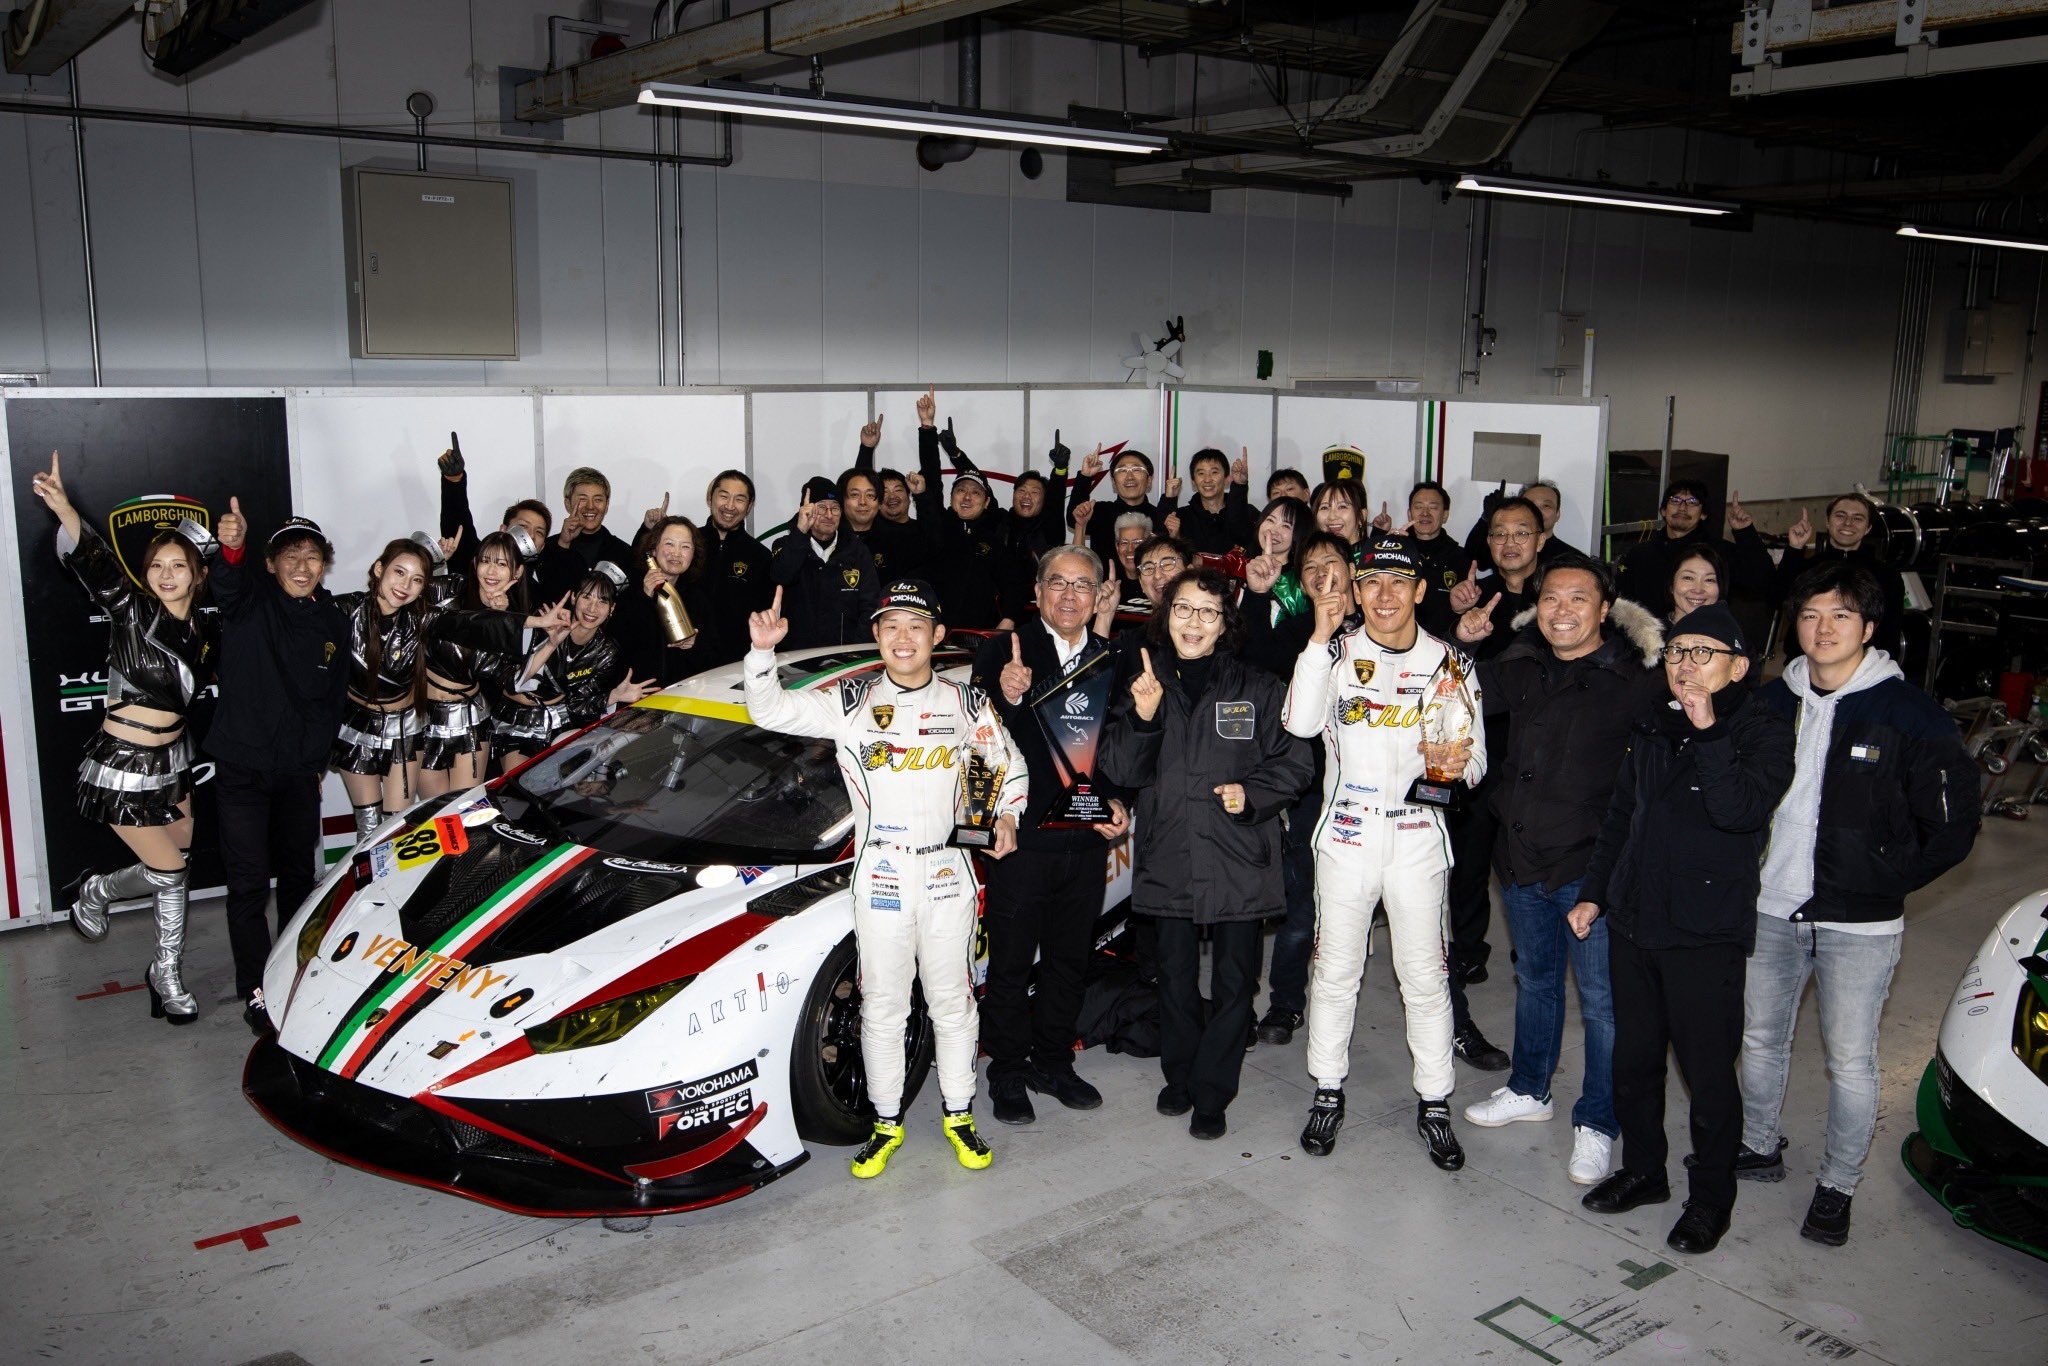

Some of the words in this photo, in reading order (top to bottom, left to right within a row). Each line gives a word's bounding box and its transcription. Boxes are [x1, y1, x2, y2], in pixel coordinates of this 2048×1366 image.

[1324, 452, 1363, 466] LAMBORGHINI
[117, 508, 202, 528] LAMBORGHINI
[1374, 552, 1412, 565] YOKOHAMA
[889, 594, 928, 607] YOKOHAMA
[891, 745, 960, 772] JLOC
[1071, 795, 1099, 803] WINNER
[395, 829, 441, 861] 88
[1332, 837, 1362, 847] YAMADA
[361, 934, 508, 999] VENTENY
[688, 972, 790, 1036] AKTIO
[677, 1065, 753, 1100] YOKOHAMA
[684, 1104, 709, 1115] MOTOR
[711, 1095, 736, 1107] SPORTS
[659, 1095, 749, 1140] FORTEC
